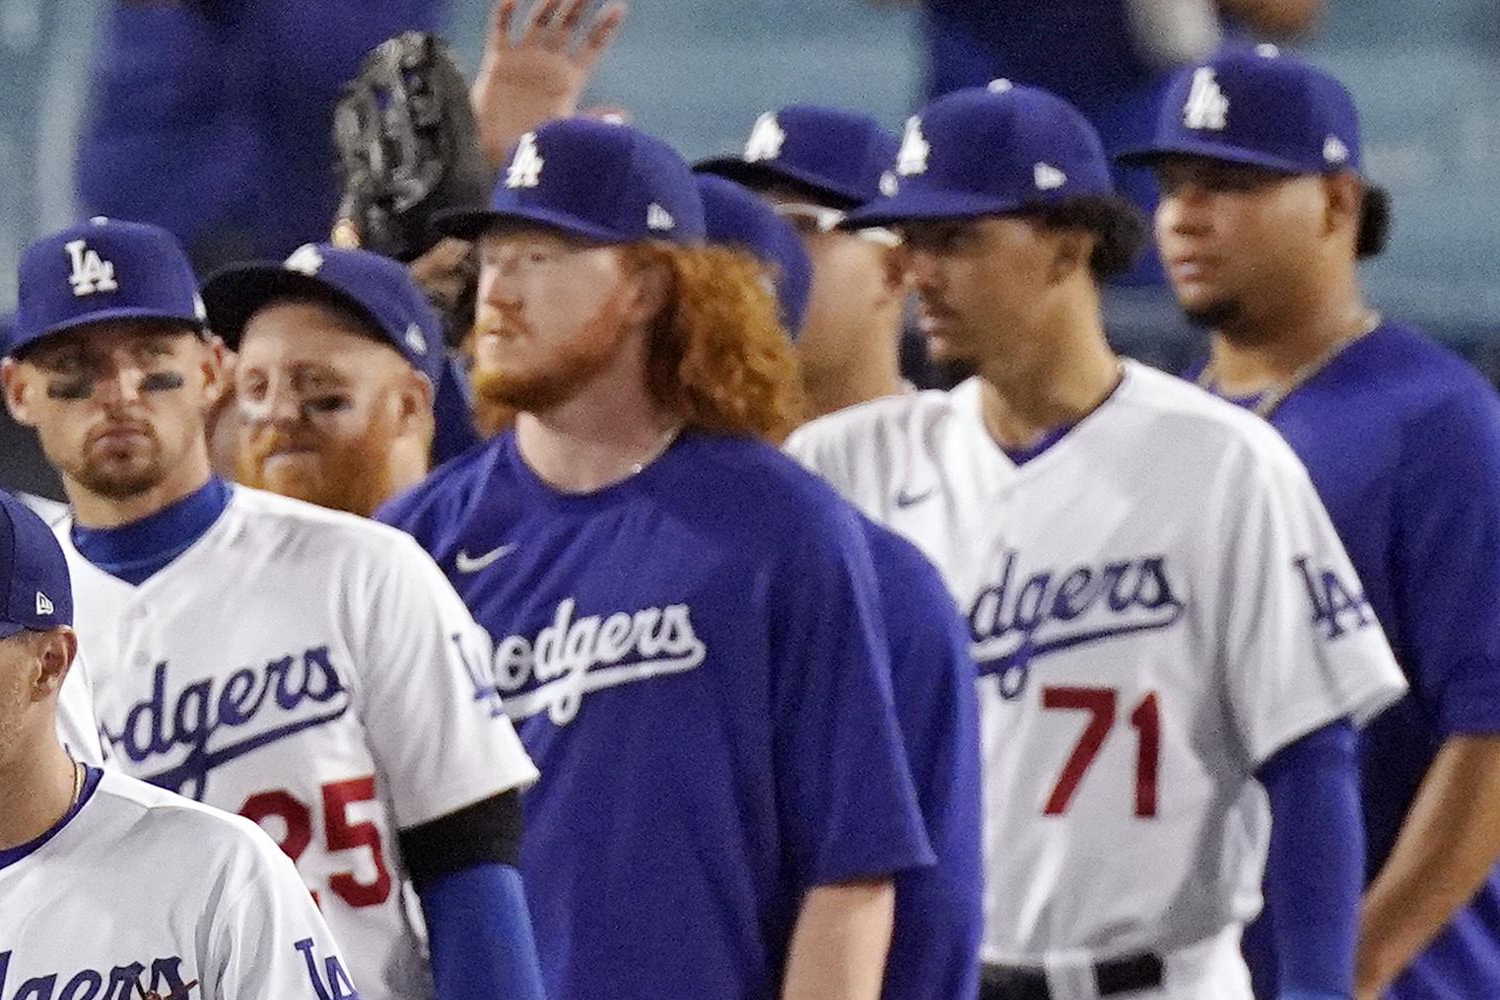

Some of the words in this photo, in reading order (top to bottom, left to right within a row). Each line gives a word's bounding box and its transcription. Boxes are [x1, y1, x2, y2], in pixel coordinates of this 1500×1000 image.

[65, 240, 118, 297] LA
[1294, 555, 1372, 641] LA
[102, 645, 350, 797] dgers
[1043, 685, 1161, 819] 71
[238, 775, 394, 907] 25
